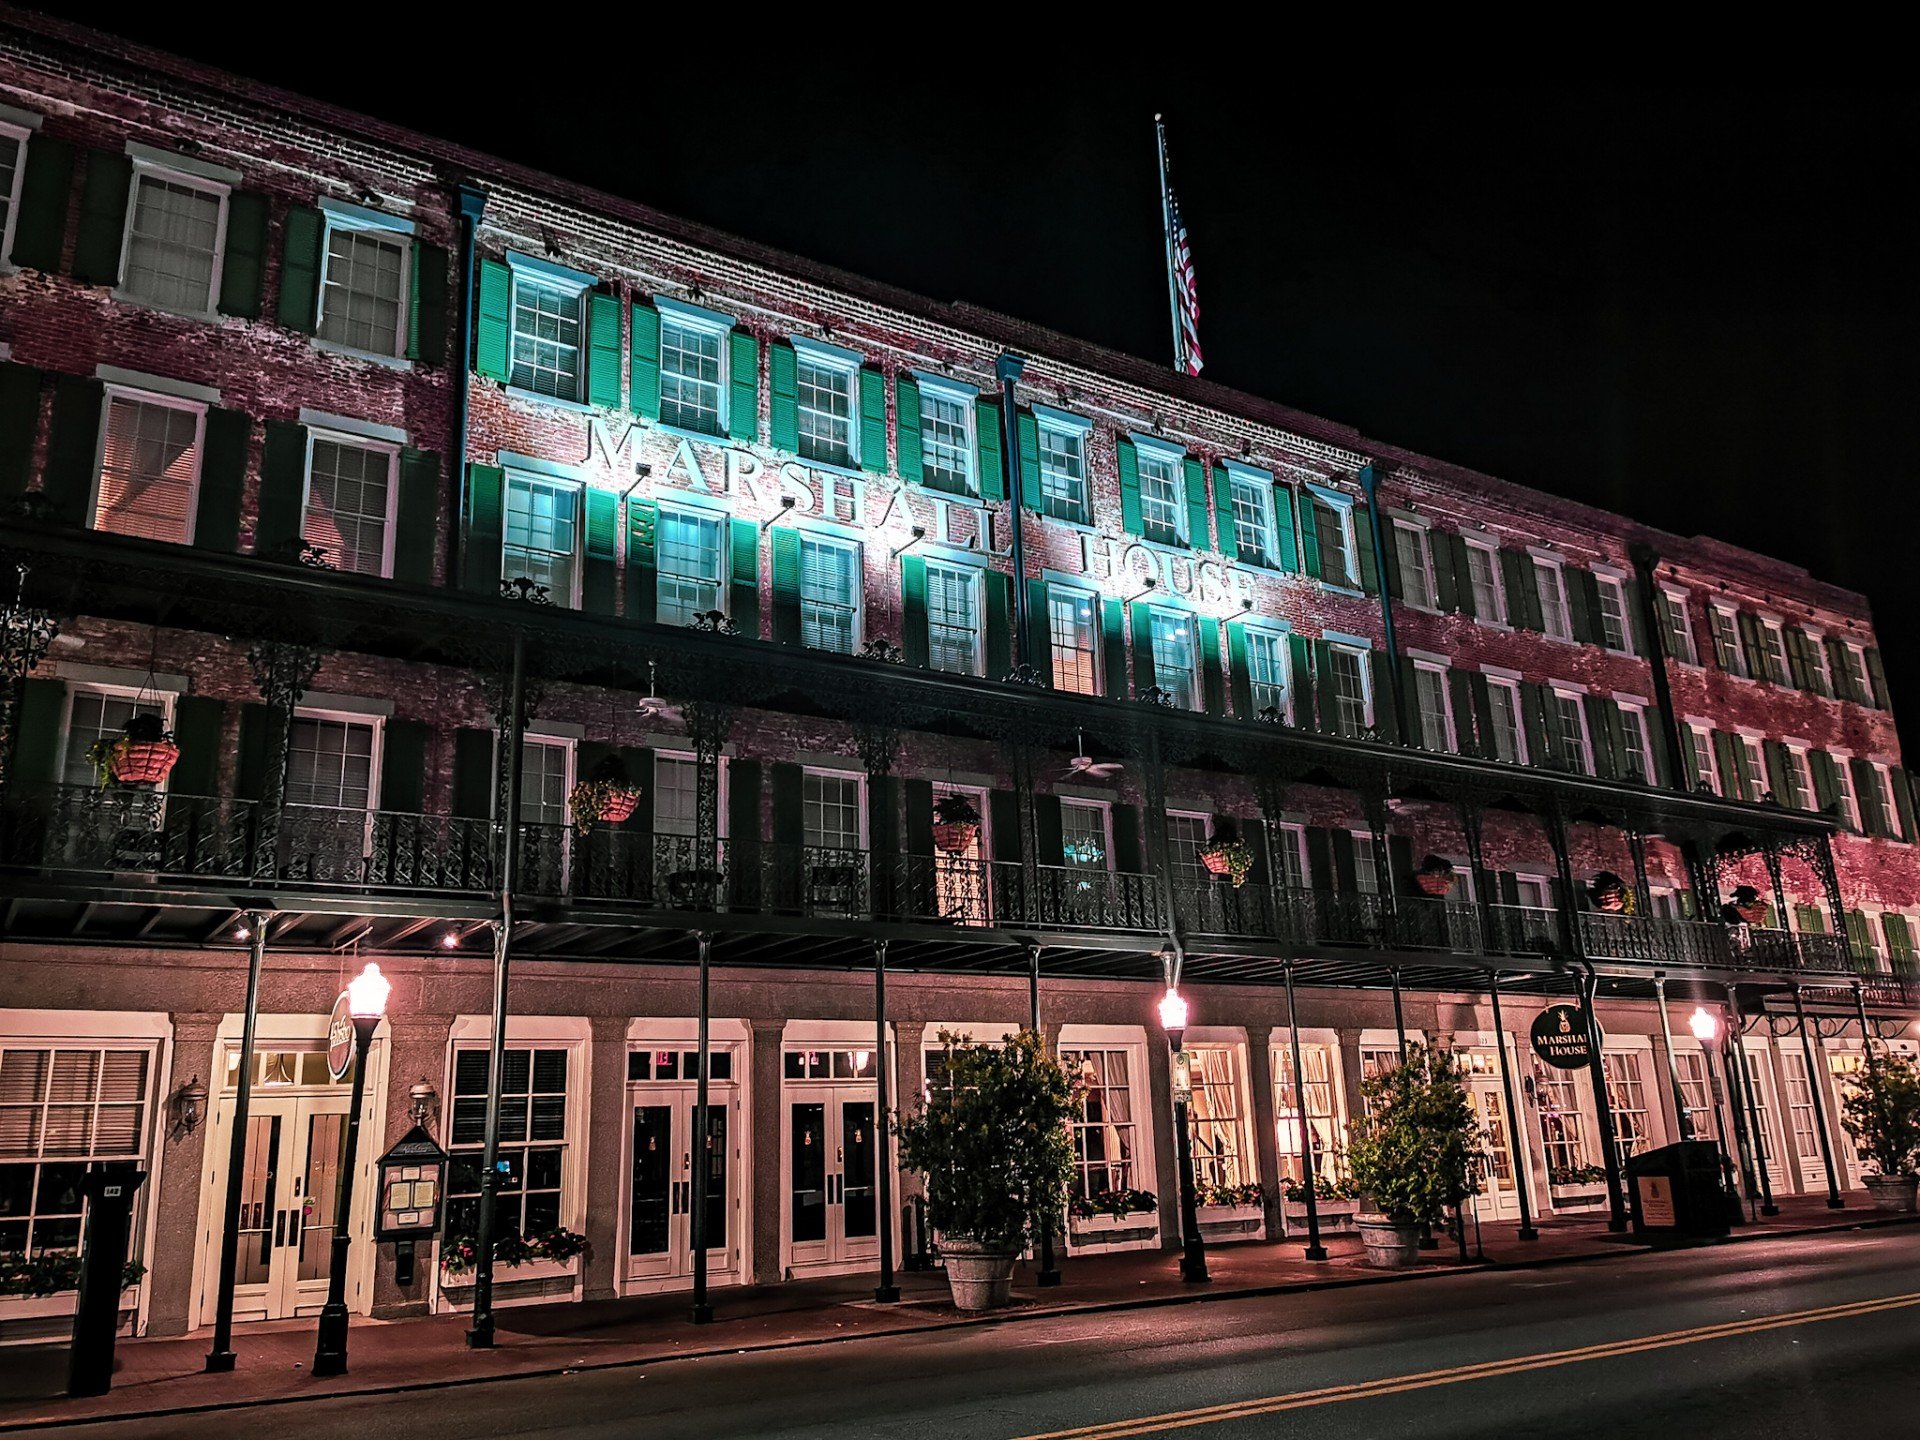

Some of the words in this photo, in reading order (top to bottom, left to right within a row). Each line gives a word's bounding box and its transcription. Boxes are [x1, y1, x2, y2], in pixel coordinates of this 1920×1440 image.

[580, 412, 1013, 558] MARSHALL
[1078, 531, 1260, 613] HOUSE
[1536, 1033, 1588, 1046] MARSHA
[1549, 1045, 1588, 1057] HOUSE
